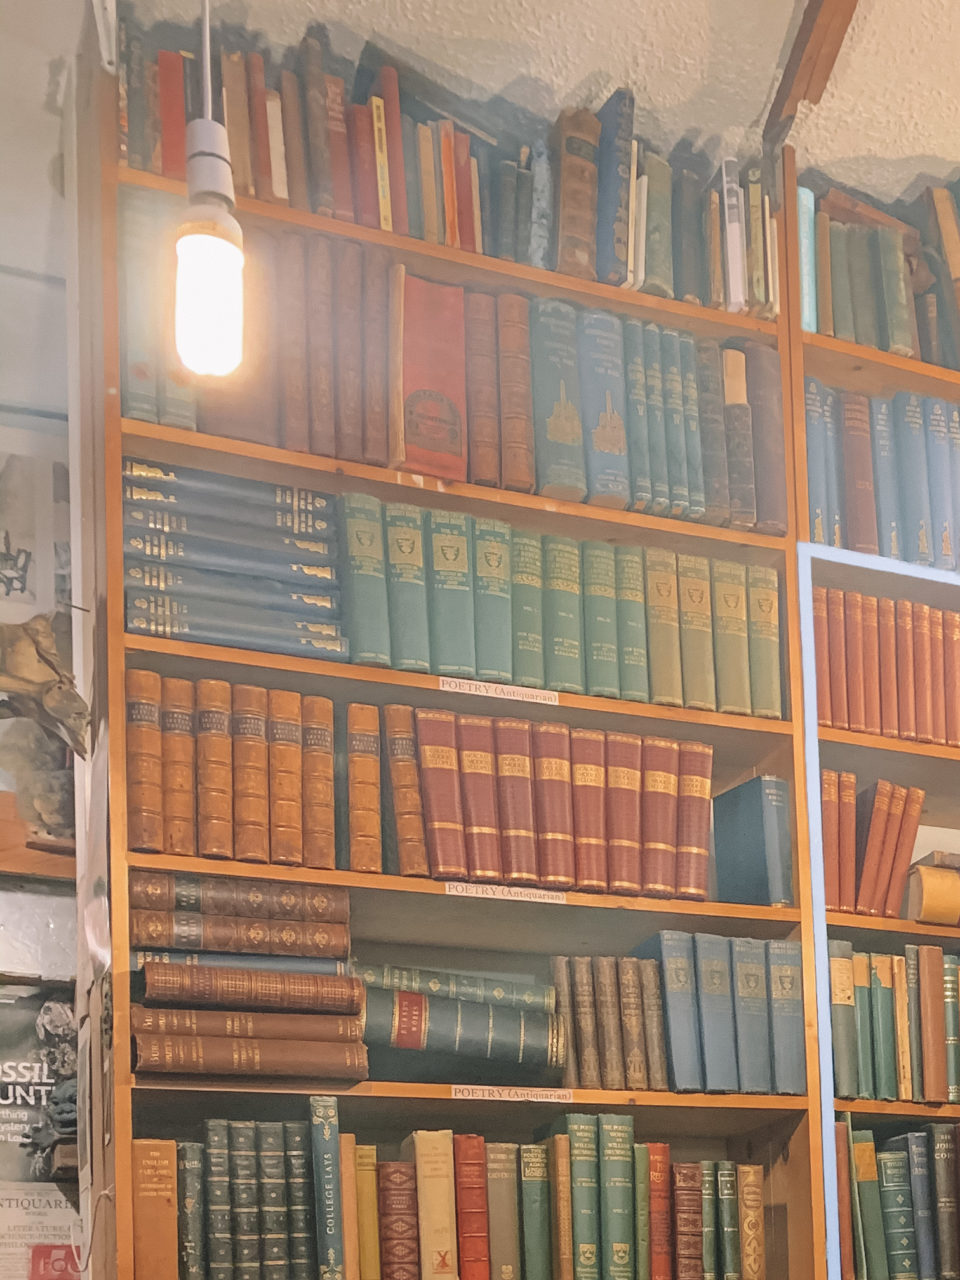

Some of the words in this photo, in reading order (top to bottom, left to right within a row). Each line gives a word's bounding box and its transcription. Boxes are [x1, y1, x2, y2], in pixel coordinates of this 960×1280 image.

[441, 679, 490, 693] POETRY
[495, 687, 557, 703] (Antiquarian)
[448, 882, 498, 896] POETRY
[502, 887, 565, 901] (Antiquarian)
[0, 1062, 55, 1083] SSIL
[0, 1085, 56, 1105] UNT
[454, 1087, 505, 1098] POETRY
[508, 1089, 572, 1101] (Antiquarian)
[325, 1153, 334, 1176] LAYS
[325, 1179, 335, 1235] COLLEGE
